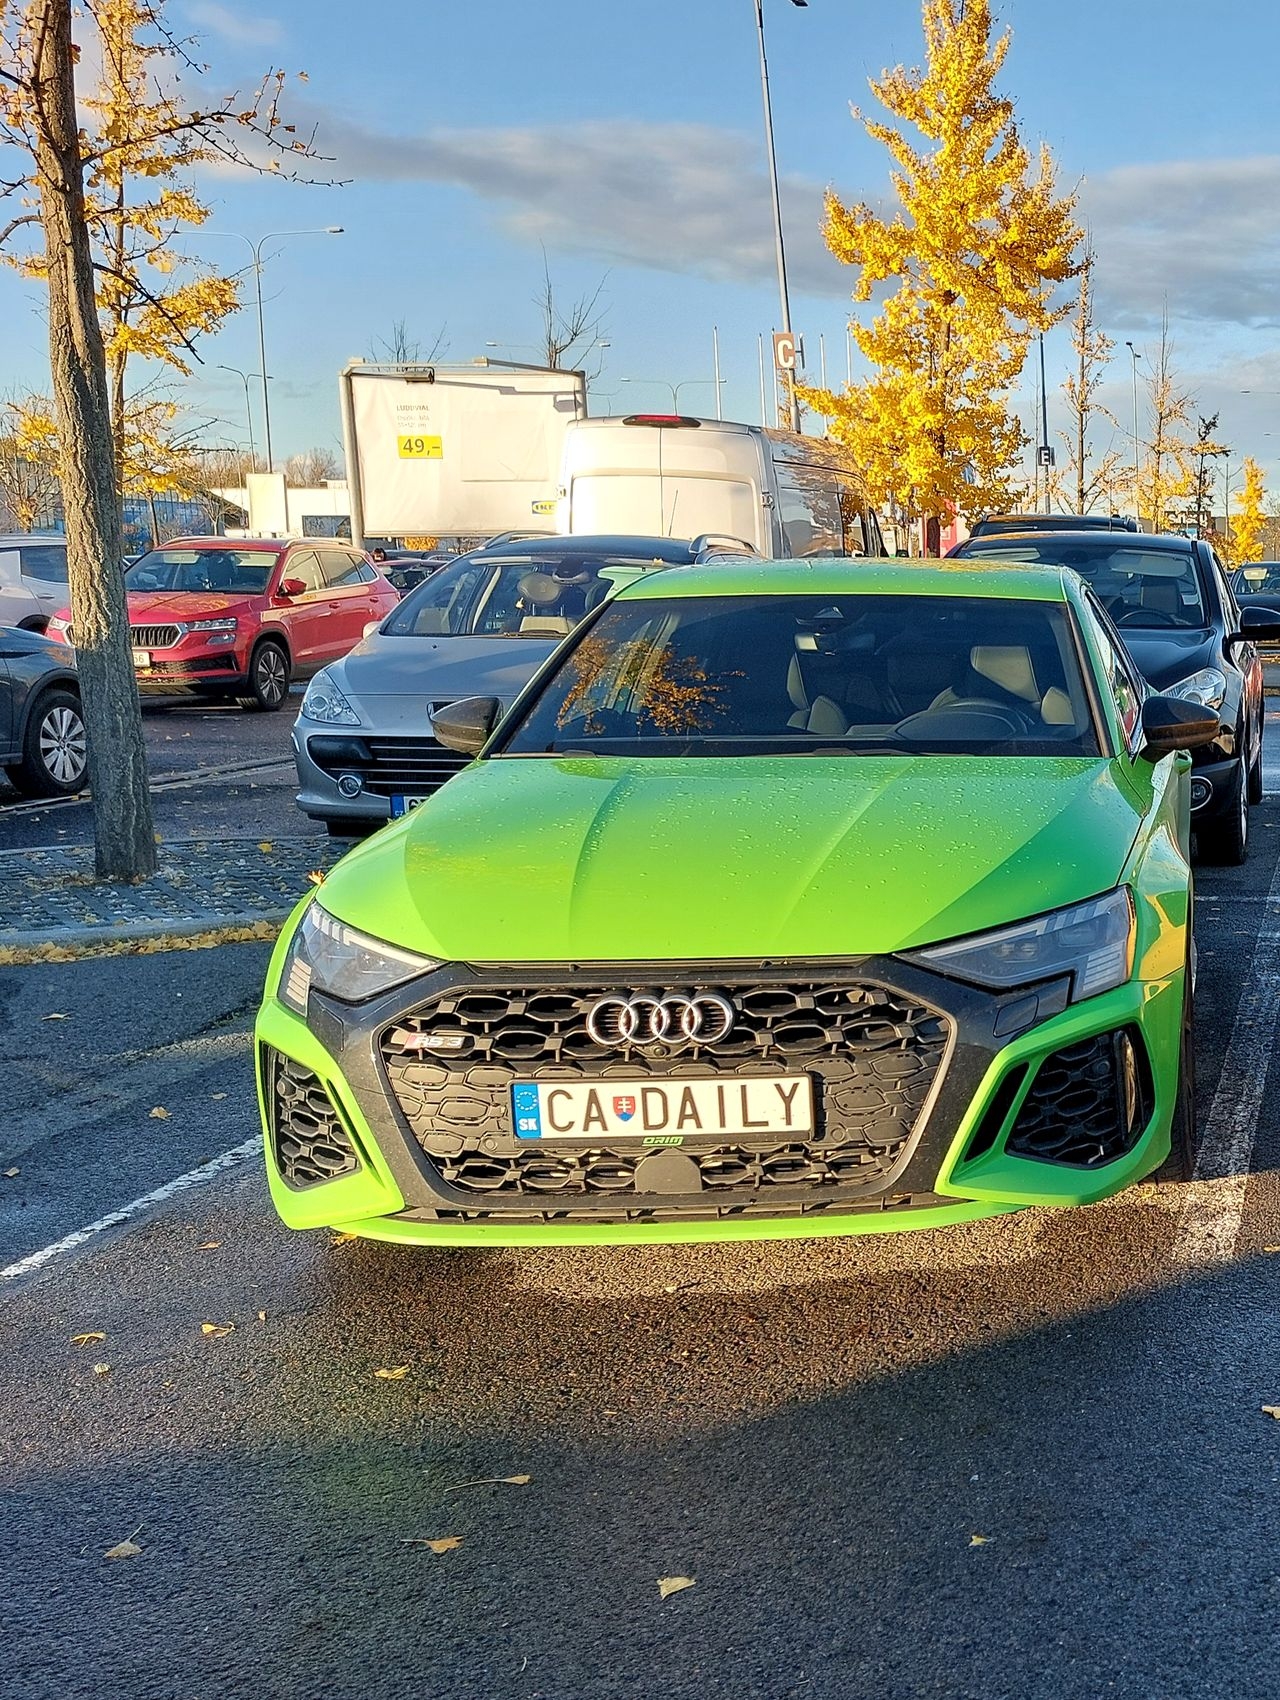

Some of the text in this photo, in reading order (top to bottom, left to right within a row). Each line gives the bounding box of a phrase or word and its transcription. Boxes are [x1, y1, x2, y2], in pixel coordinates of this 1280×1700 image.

[777, 339, 795, 369] C
[1041, 450, 1050, 465] E
[518, 1081, 800, 1132] SK CA DAILY
